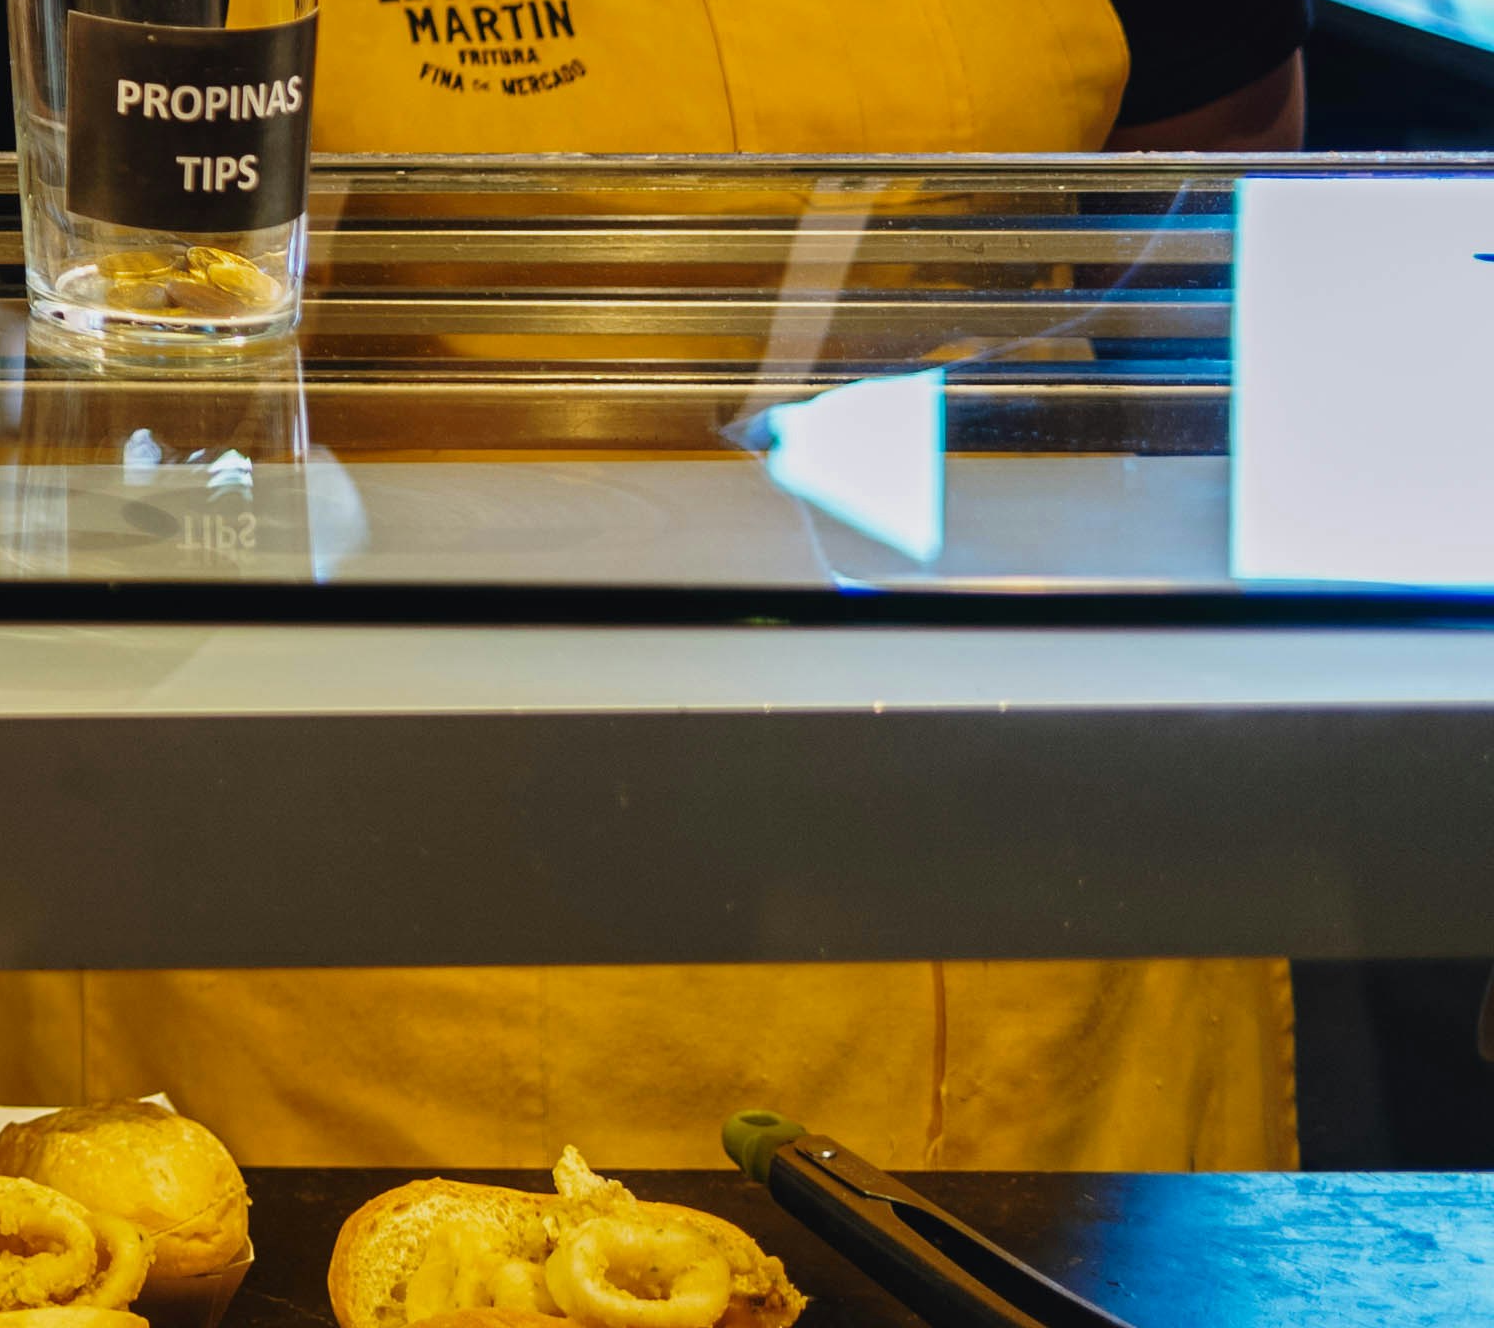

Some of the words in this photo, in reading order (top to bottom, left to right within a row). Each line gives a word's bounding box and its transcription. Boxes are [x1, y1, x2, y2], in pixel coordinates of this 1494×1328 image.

[405, 0, 575, 44] MARTIN
[459, 47, 540, 66] FRITURA
[420, 62, 465, 92] FINA
[501, 59, 586, 96] MERCADO
[116, 73, 304, 123] PROPINAS
[175, 153, 260, 193] TIPS
